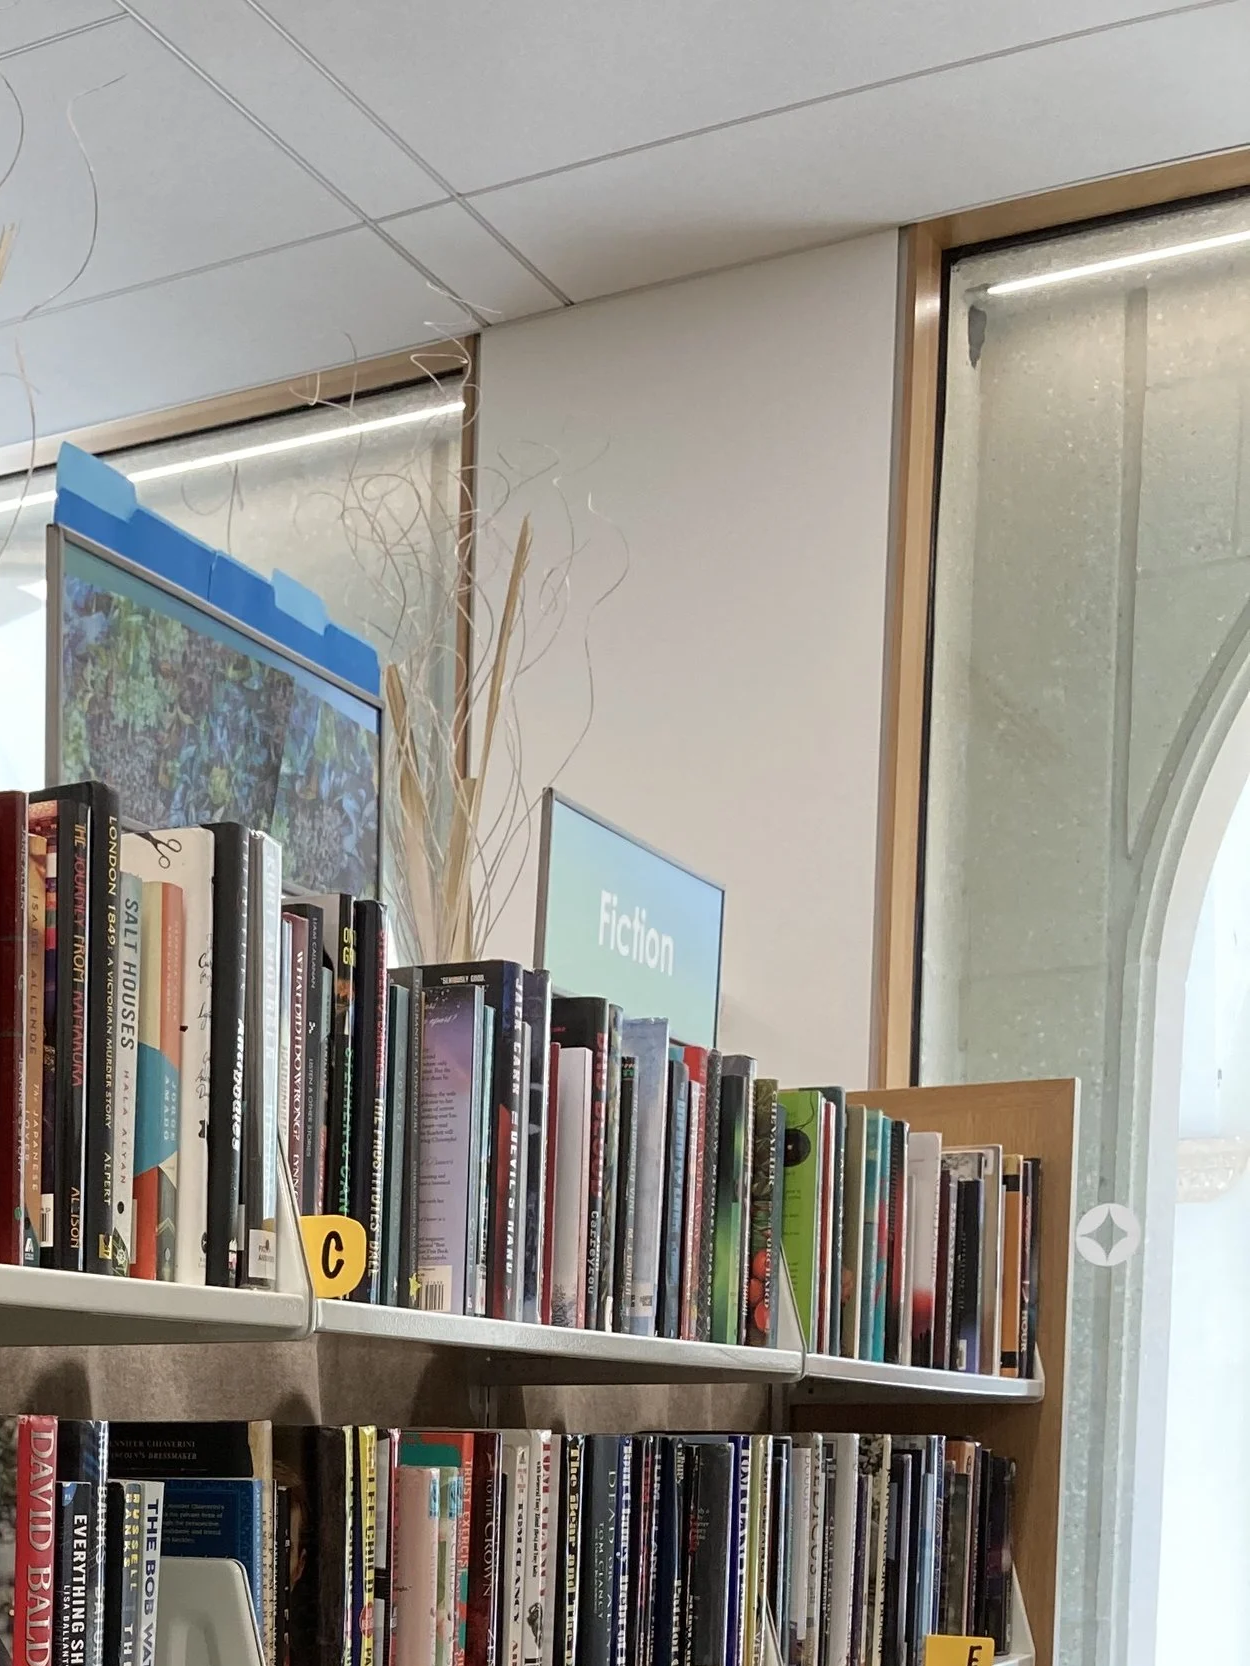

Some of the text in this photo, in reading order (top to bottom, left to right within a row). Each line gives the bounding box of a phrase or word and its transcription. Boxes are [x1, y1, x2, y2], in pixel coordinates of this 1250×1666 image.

[107, 815, 118, 897] LONDON
[120, 898, 139, 1051] SALT HOUSES
[597, 890, 675, 978] Fiction
[511, 977, 524, 1096] JACK CARR
[321, 1230, 345, 1280] C
[28, 1427, 56, 1551] DAVID
[147, 1451, 198, 1461] DRESSMAKER
[72, 1514, 89, 1633] EVERYTHING
